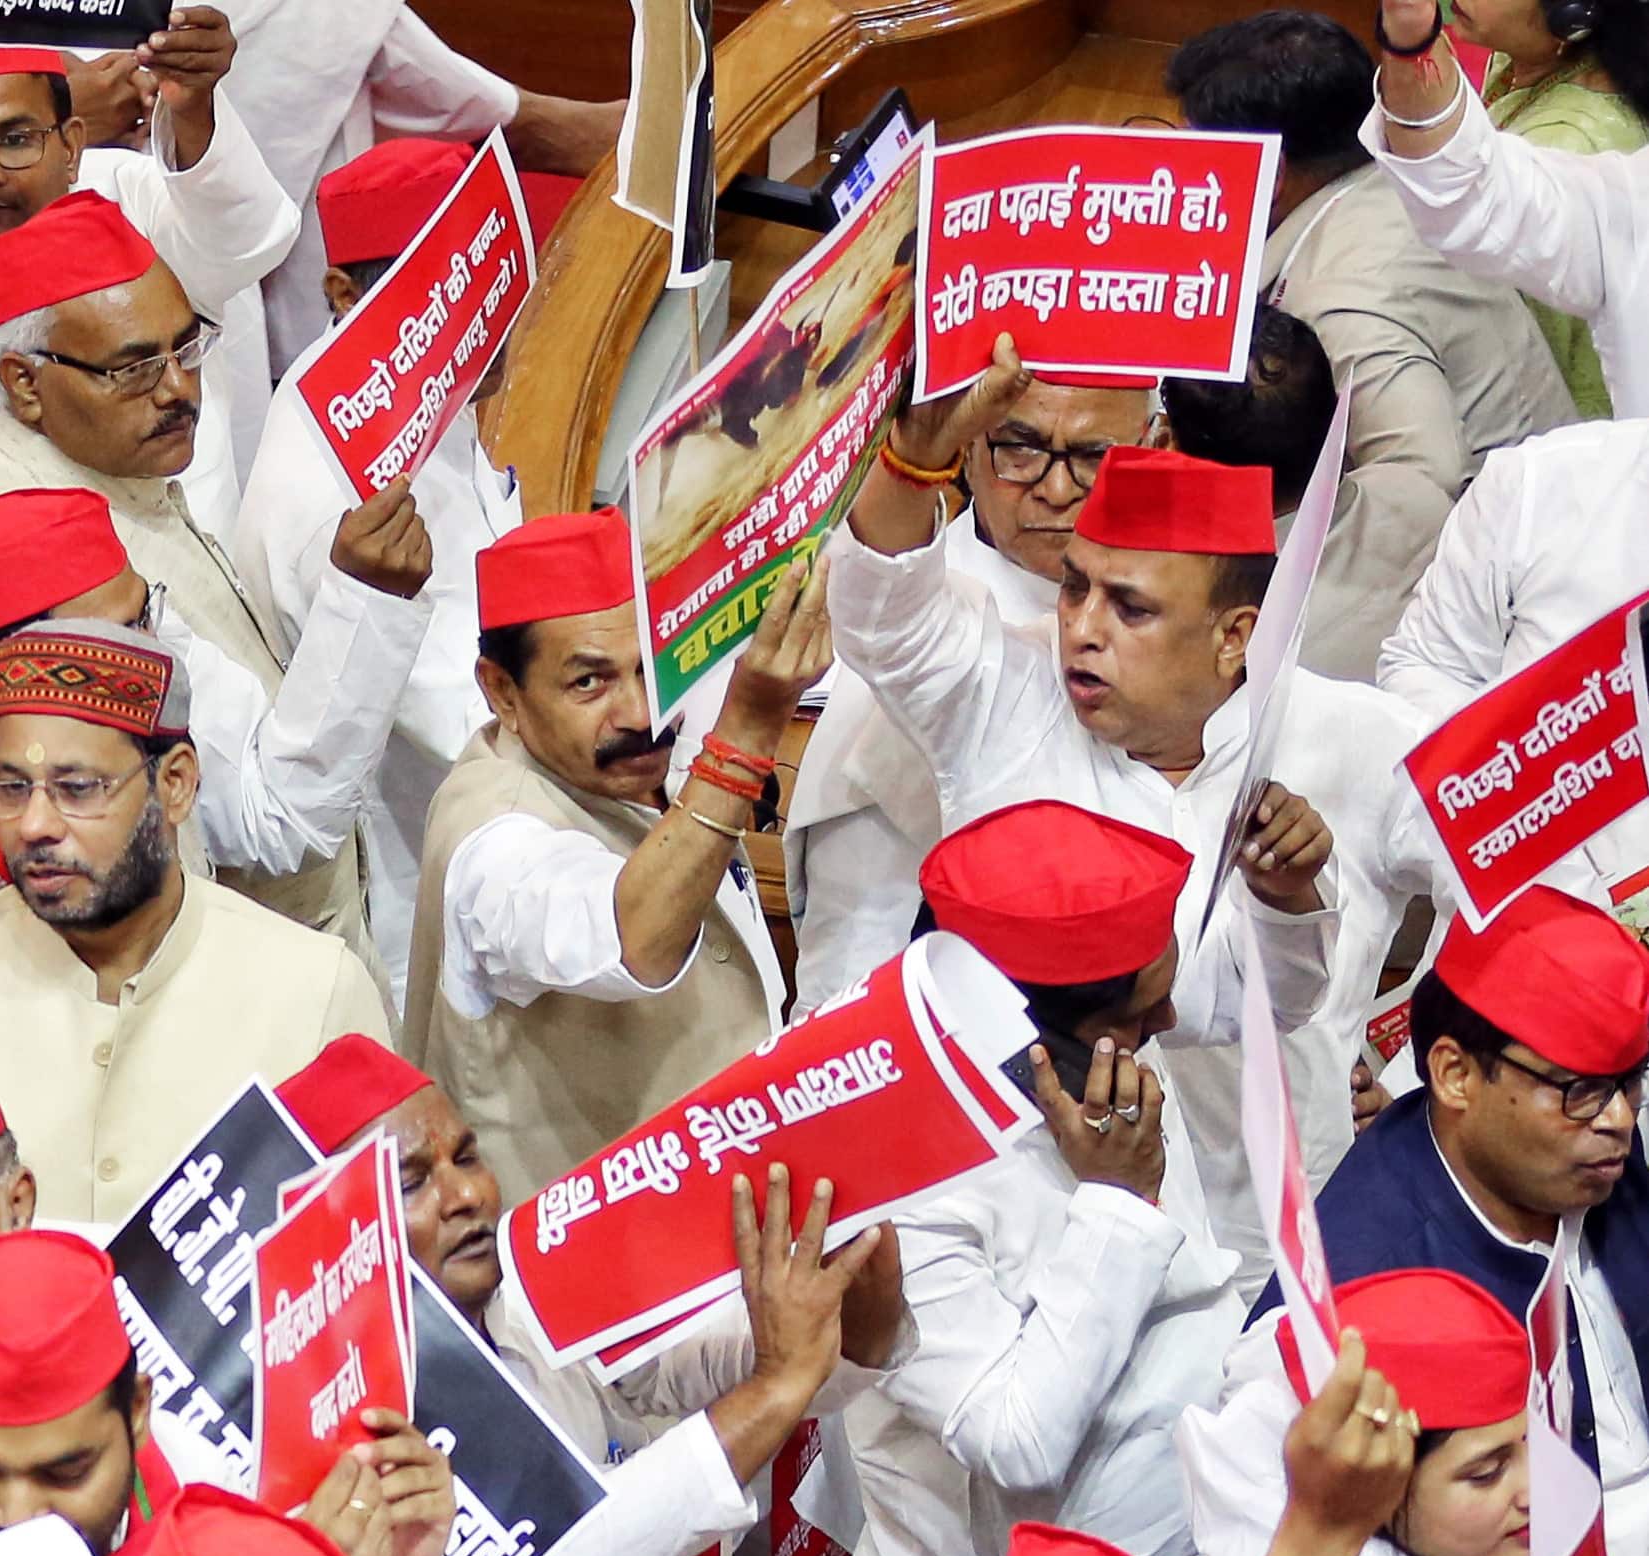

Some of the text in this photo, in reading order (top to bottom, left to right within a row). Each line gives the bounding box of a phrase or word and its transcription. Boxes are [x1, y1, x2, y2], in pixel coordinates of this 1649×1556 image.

[942, 165, 1228, 245] दवा पढ़ाई मुफ्ती हो,
[443, 252, 474, 305] की
[453, 307, 490, 369] चालू
[482, 250, 519, 320] करो।
[932, 263, 978, 334] रोटी
[981, 268, 1074, 323] कपड़ा
[1078, 268, 1169, 315] सस्ता
[1172, 260, 1230, 320] हो।
[656, 559, 735, 641] रोजाना
[738, 535, 768, 574] हो
[772, 501, 810, 548] रही
[1519, 669, 1608, 758] दलितों
[1467, 748, 1614, 870] स्कालरशिप
[536, 1037, 903, 1254] आरक्षण कोई भीख नहीं
